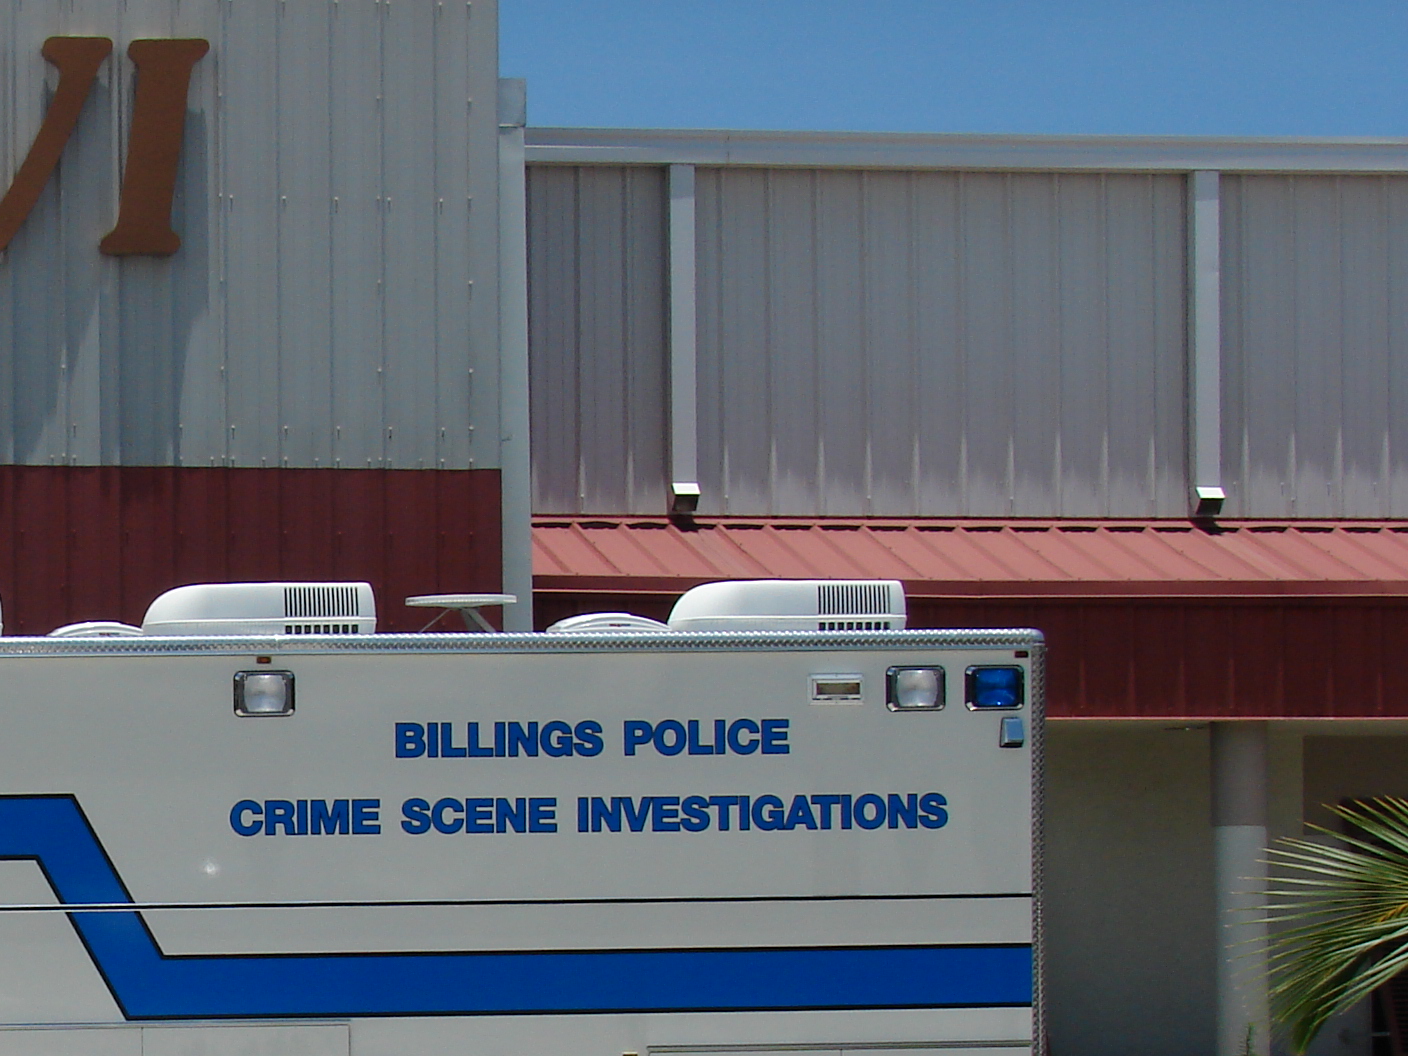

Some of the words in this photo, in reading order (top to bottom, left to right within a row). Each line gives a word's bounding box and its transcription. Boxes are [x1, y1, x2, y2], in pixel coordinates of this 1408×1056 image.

[394, 720, 604, 758] BILLINGS
[623, 718, 790, 756] POLICE
[229, 798, 382, 837] CRIME
[400, 797, 558, 835] SCENE
[577, 792, 949, 833] INVESTIGATIONS
